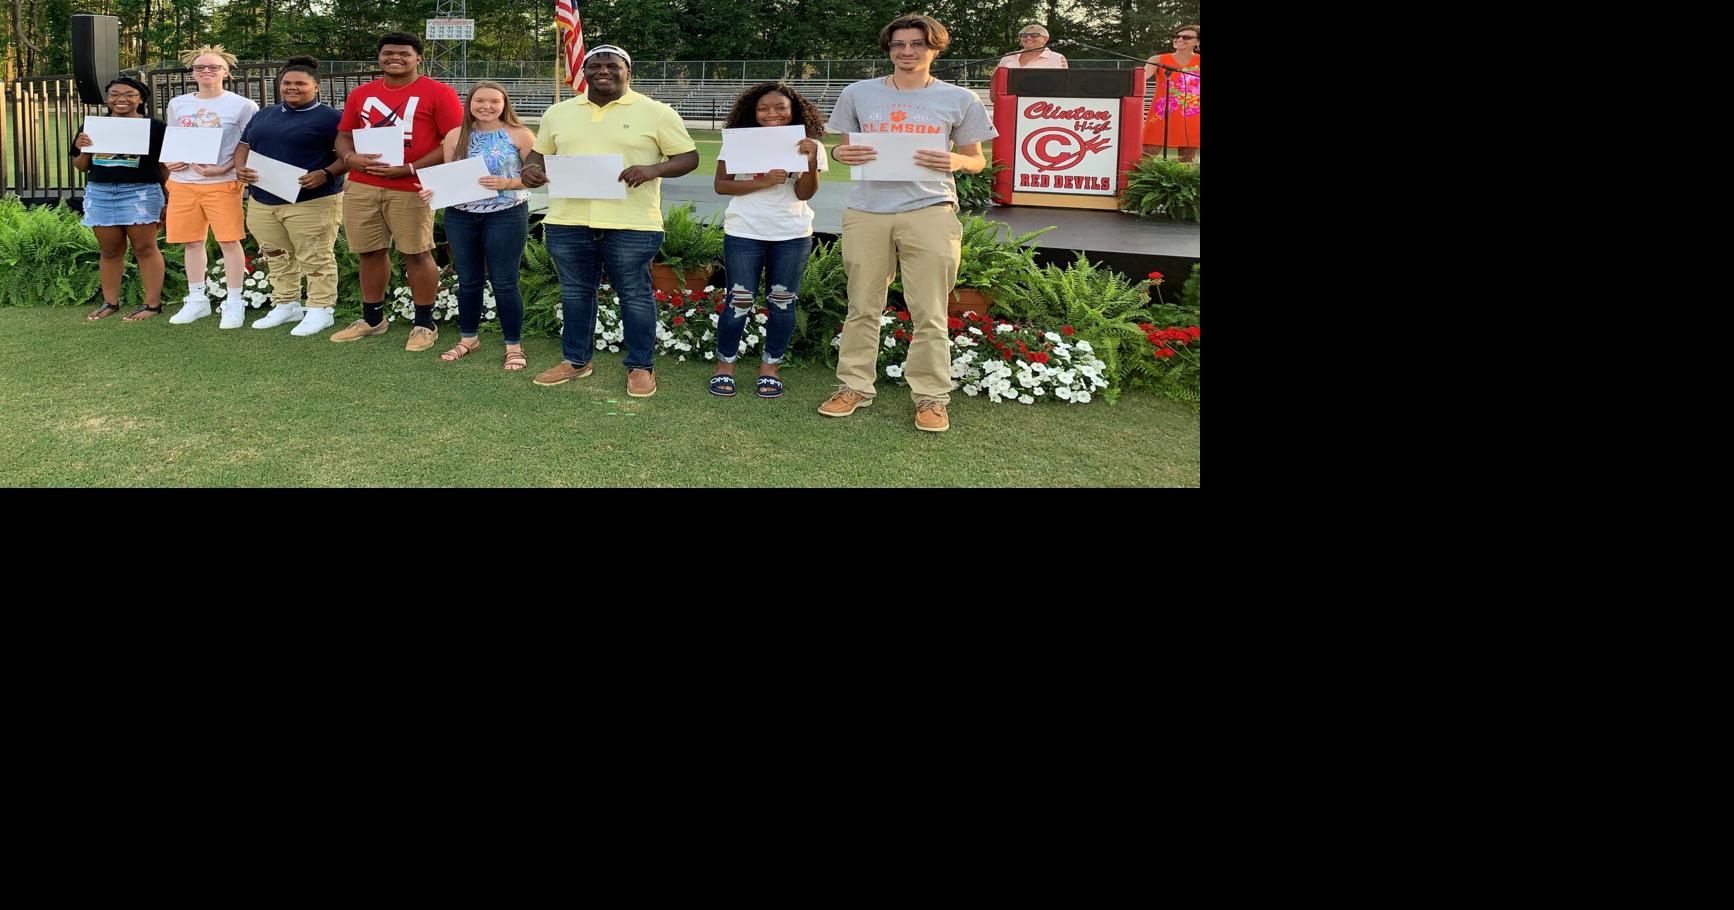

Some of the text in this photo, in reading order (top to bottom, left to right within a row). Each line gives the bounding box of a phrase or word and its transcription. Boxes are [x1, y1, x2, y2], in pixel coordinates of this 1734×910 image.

[1023, 100, 1112, 121] Clinton
[863, 123, 941, 134] CLEMSON
[1074, 120, 1112, 134] High
[1035, 134, 1072, 164] C
[1020, 173, 1110, 191] RED DEVILS
